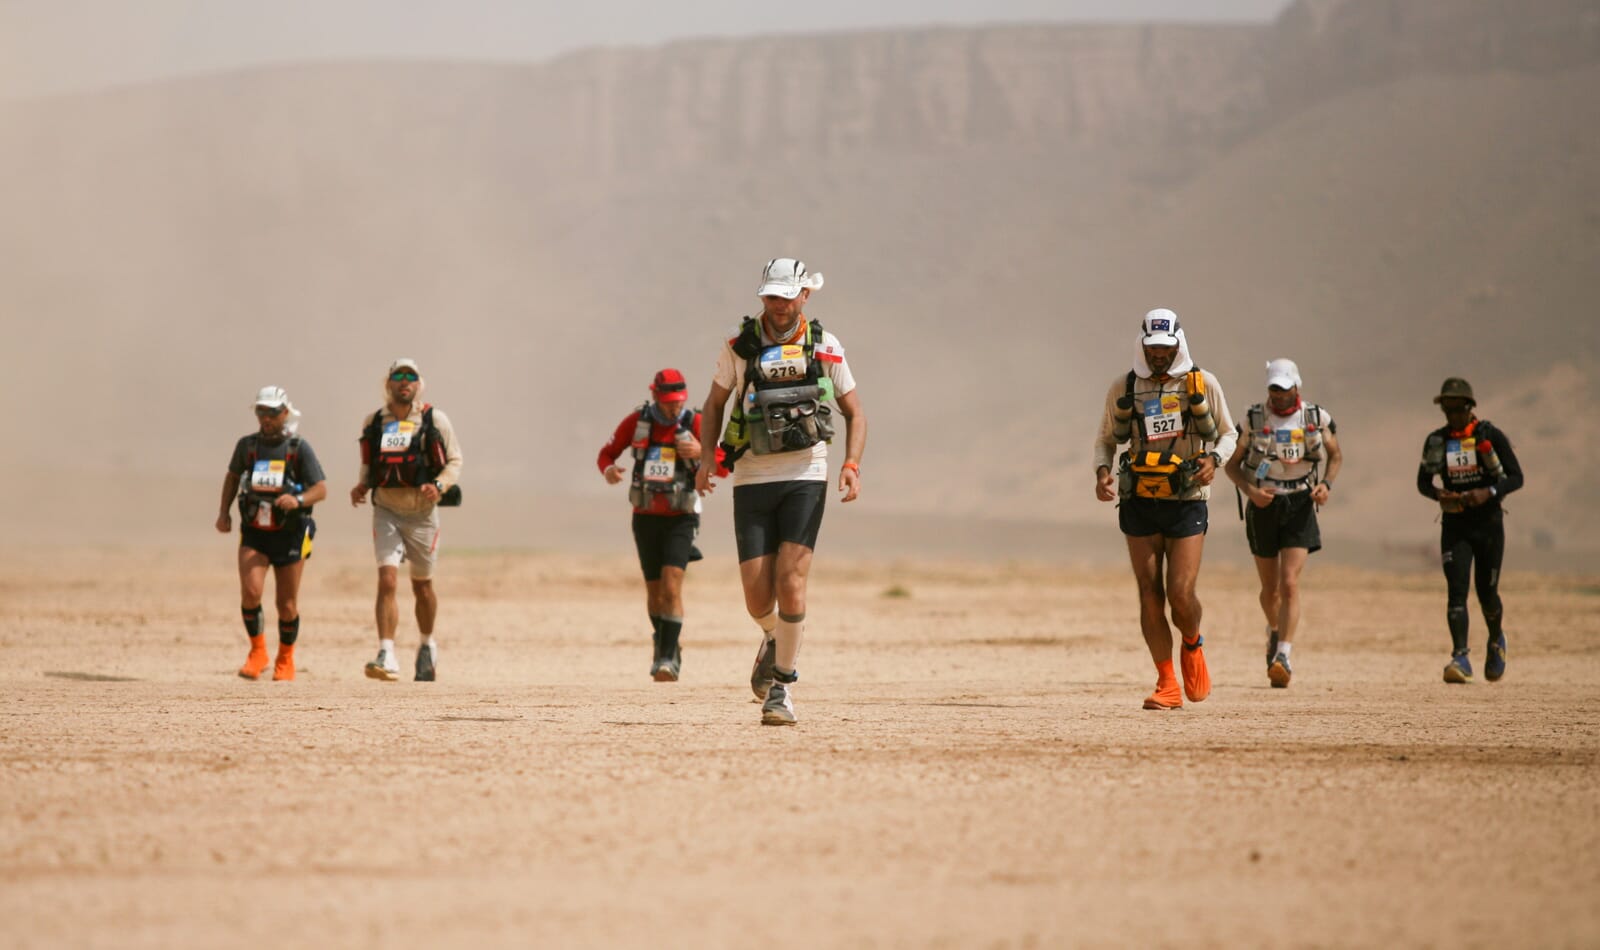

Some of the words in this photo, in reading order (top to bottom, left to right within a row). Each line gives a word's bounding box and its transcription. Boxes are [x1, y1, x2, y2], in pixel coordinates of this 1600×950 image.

[770, 366, 797, 378] 278
[1153, 418, 1175, 433] 527
[386, 436, 406, 446] 502
[1282, 448, 1299, 458] 191
[1456, 455, 1468, 466] 13
[650, 465, 669, 476] 532
